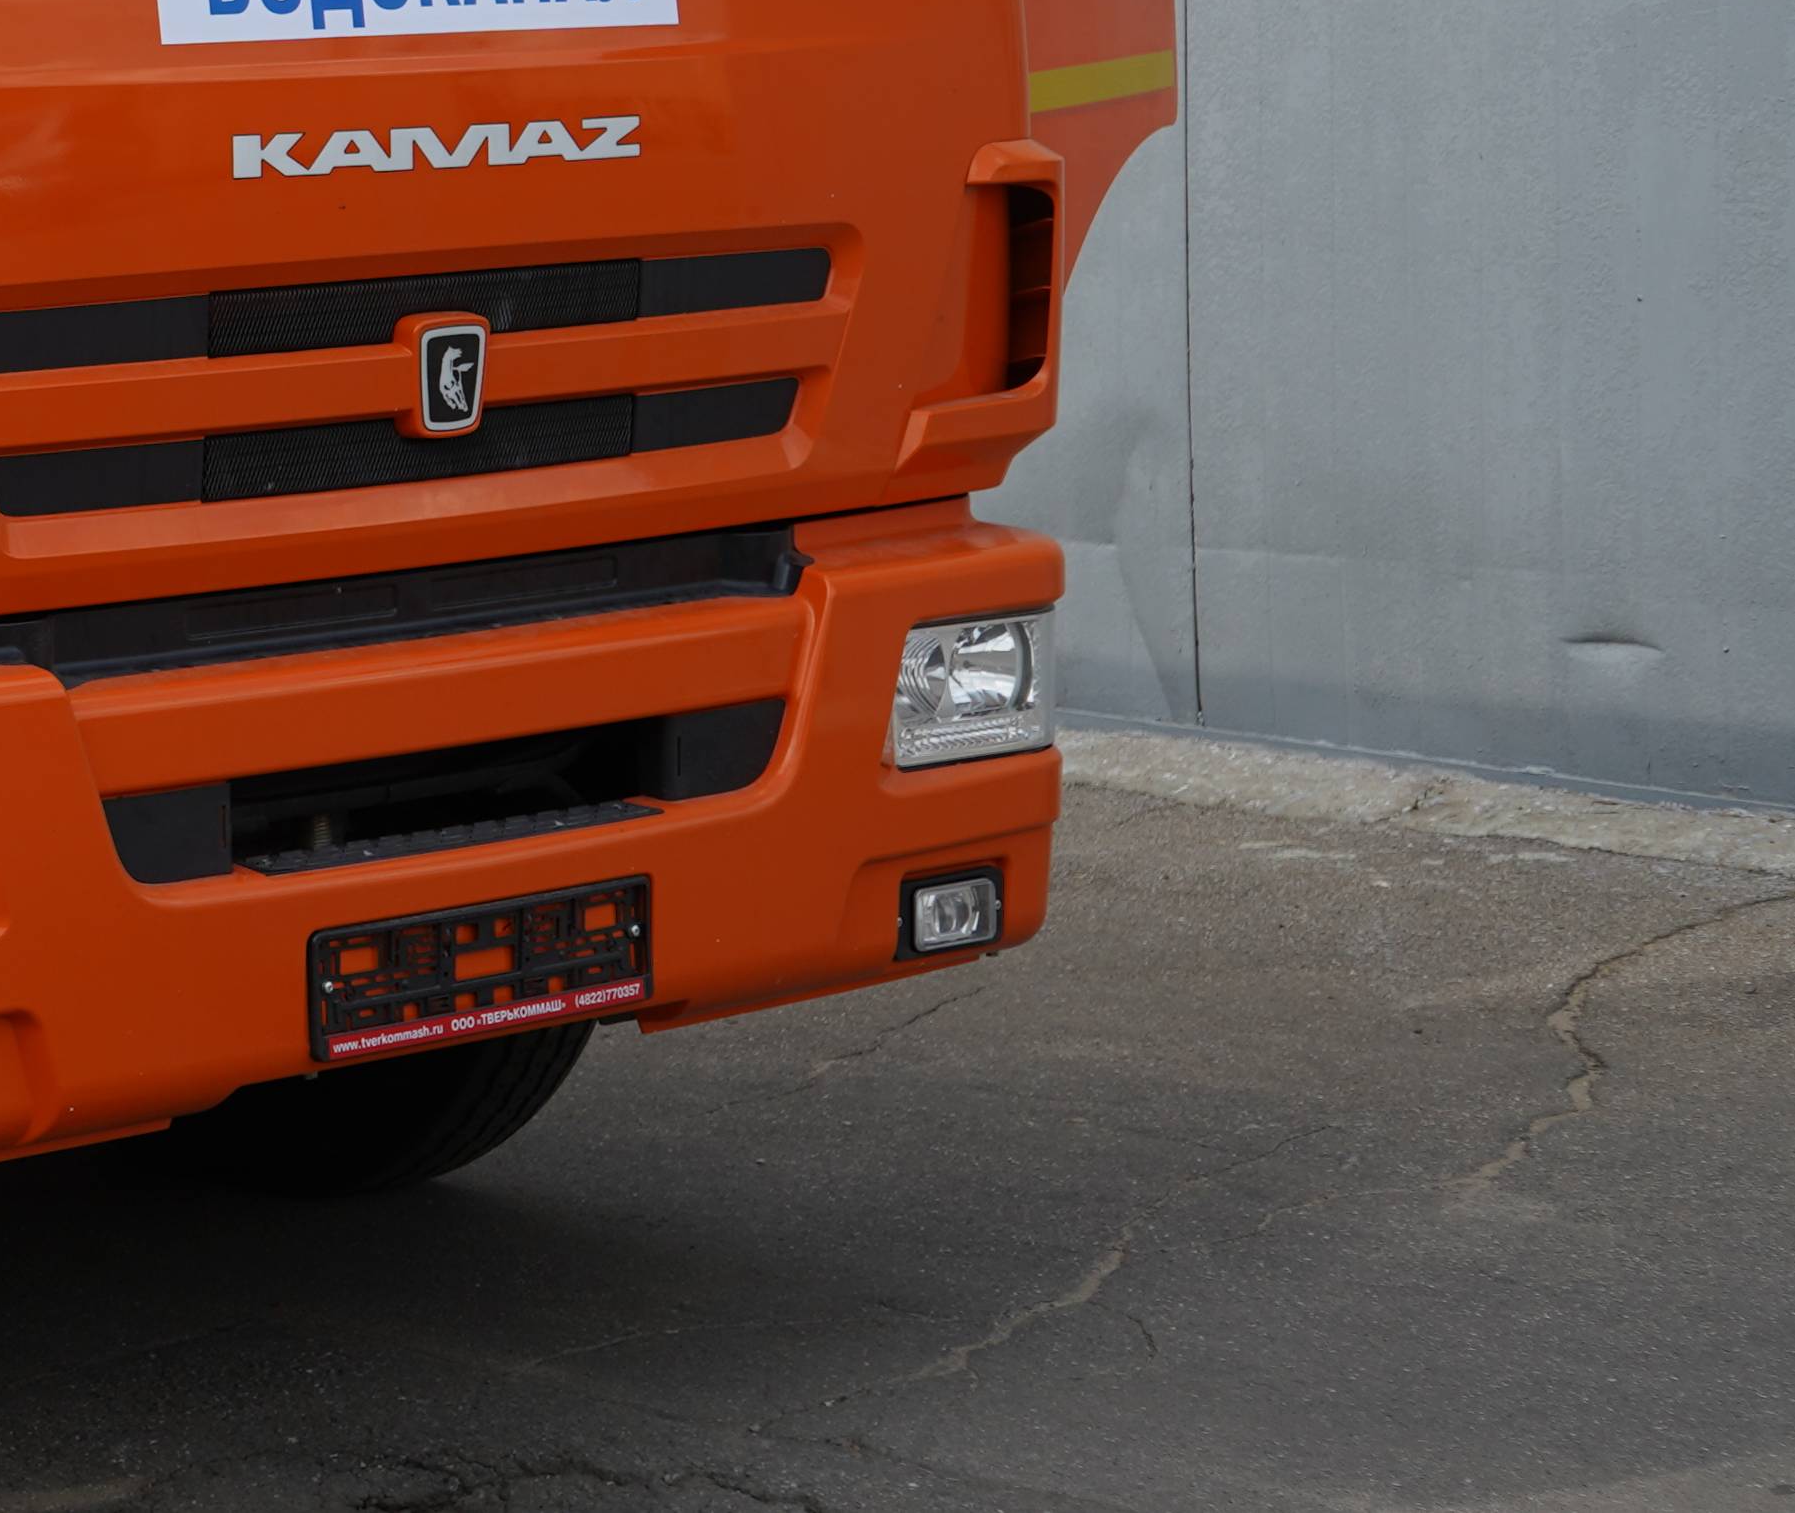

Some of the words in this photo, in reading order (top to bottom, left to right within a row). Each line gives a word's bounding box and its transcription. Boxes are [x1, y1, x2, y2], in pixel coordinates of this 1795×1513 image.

[232, 114, 642, 179] KAMAZ
[332, 1022, 444, 1054] www.tverkommash.ru
[575, 982, 641, 1008] (4822)770357
